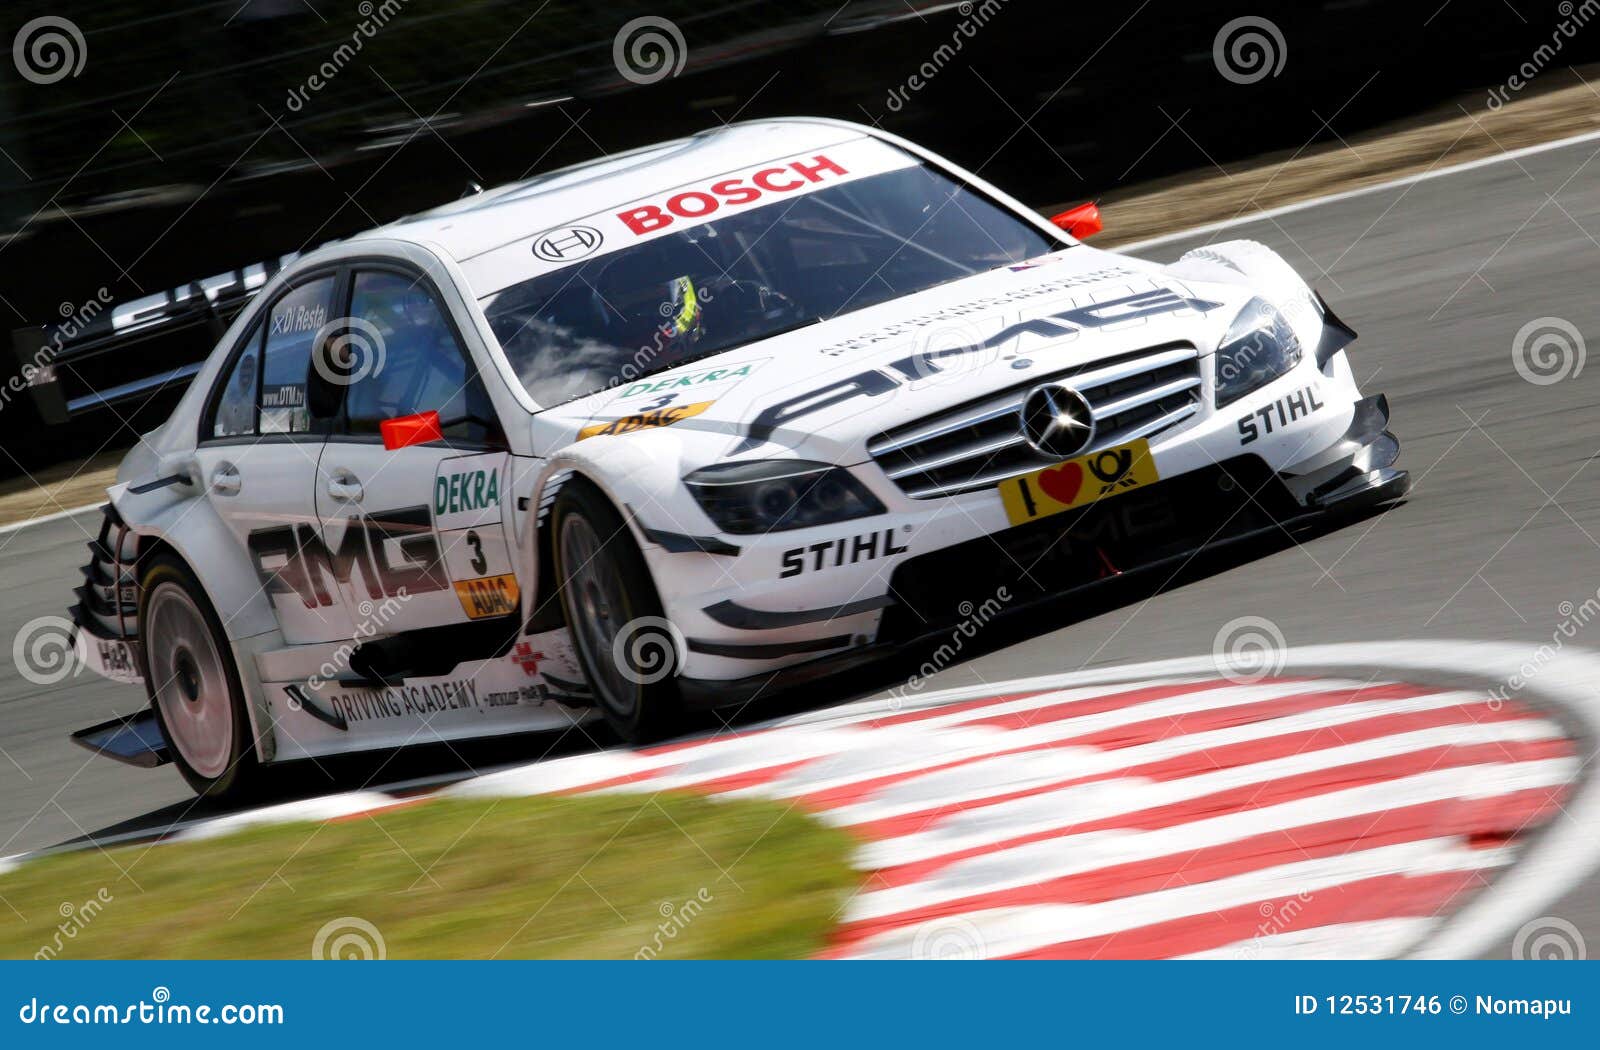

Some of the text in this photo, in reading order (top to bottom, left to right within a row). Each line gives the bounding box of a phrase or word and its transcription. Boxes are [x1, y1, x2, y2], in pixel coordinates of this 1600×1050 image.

[616, 155, 849, 236] BOSCH
[620, 364, 753, 399] DEKRA
[639, 393, 680, 413] 3
[597, 405, 689, 437] ADAC
[1237, 385, 1325, 446] STIHL
[435, 467, 500, 516] DEKRA
[247, 503, 450, 610] AMG
[466, 530, 488, 576] 3
[779, 528, 909, 579] STIHL
[467, 577, 516, 616] ADAC
[330, 689, 402, 722] DRIVING
[401, 678, 480, 715] ACADEMY
